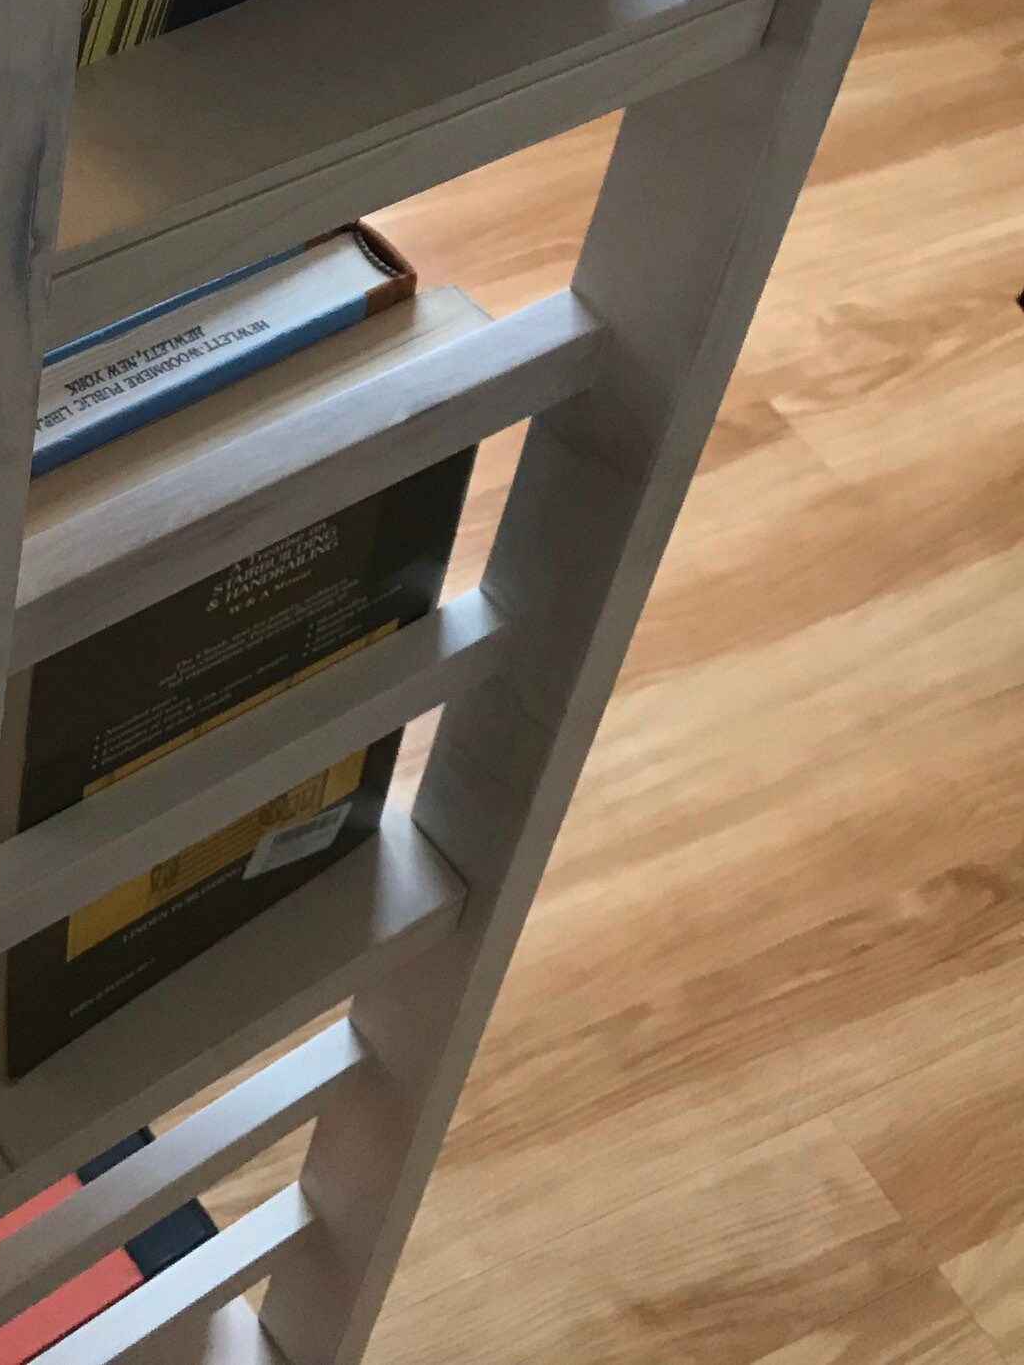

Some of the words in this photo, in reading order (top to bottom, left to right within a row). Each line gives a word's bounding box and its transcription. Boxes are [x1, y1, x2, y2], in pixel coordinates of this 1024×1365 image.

[63, 366, 107, 397] YORK
[107, 355, 139, 378] NEW
[72, 377, 126, 413] PUBLIC
[211, 527, 339, 598] STAIRBUILDING
[224, 540, 340, 606] HANDRAILING
